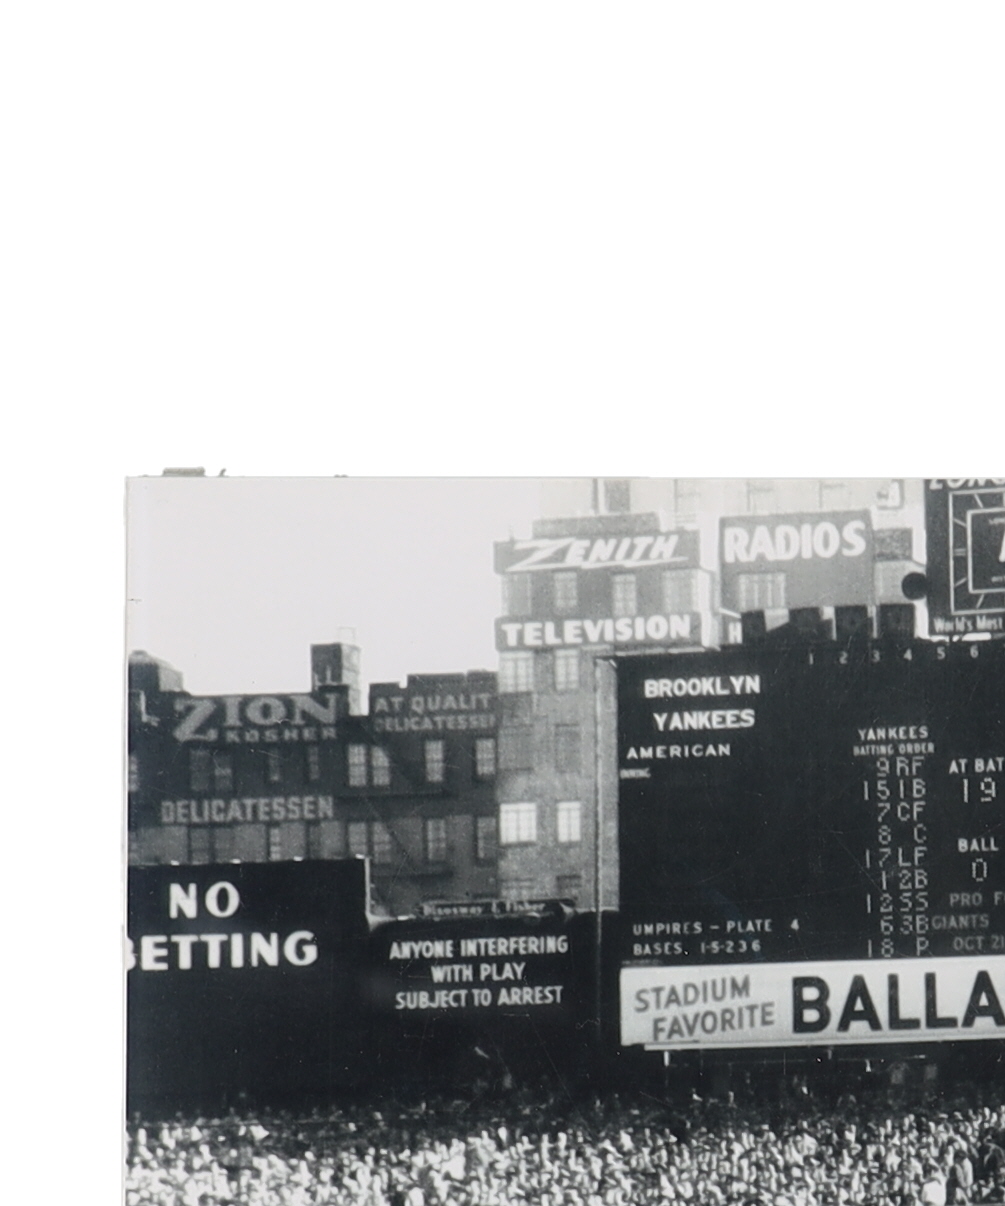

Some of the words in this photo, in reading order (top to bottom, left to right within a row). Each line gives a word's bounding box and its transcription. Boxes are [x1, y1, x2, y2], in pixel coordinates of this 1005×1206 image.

[724, 521, 866, 563] RADIOS
[505, 535, 688, 571] ZENITH
[501, 614, 691, 647] TELEVISION
[975, 614, 1003, 630] Most
[838, 651, 848, 665] 2
[872, 649, 880, 663] 3
[903, 648, 913, 661] 4
[936, 646, 946, 660] 5
[969, 645, 979, 659] 6
[644, 674, 761, 698] BROOKLYN
[411, 693, 490, 715] QUALIT
[173, 693, 337, 742] ZION
[653, 708, 755, 732] YANKEES
[225, 726, 337, 743] KOSHER
[858, 725, 929, 742] YANKEES
[626, 743, 731, 760] AMERICAN
[853, 744, 894, 757] BATTING
[899, 742, 935, 754] ORDER
[948, 758, 968, 774] AT
[974, 757, 1005, 773] BAT
[161, 795, 334, 823] DELICATESSEN
[957, 837, 999, 853] BALL
[169, 881, 240, 919] NO
[949, 892, 982, 907] PRO
[633, 921, 703, 936] UMPIRES
[726, 918, 773, 933] PLATE
[790, 918, 799, 931] 4
[931, 913, 990, 930] GIANTS
[389, 940, 454, 960] ANYONE
[460, 935, 569, 957] INTERFERING
[953, 935, 984, 950] OCT
[991, 935, 1005, 949] 21
[431, 964, 474, 983] WITH
[480, 962, 526, 982] PLAY
[395, 989, 468, 1010] SUBJECT
[471, 988, 492, 1007] TO
[497, 985, 564, 1007] ARREST
[634, 974, 751, 1013] STADIUM
[653, 1001, 775, 1041] FAVORITE
